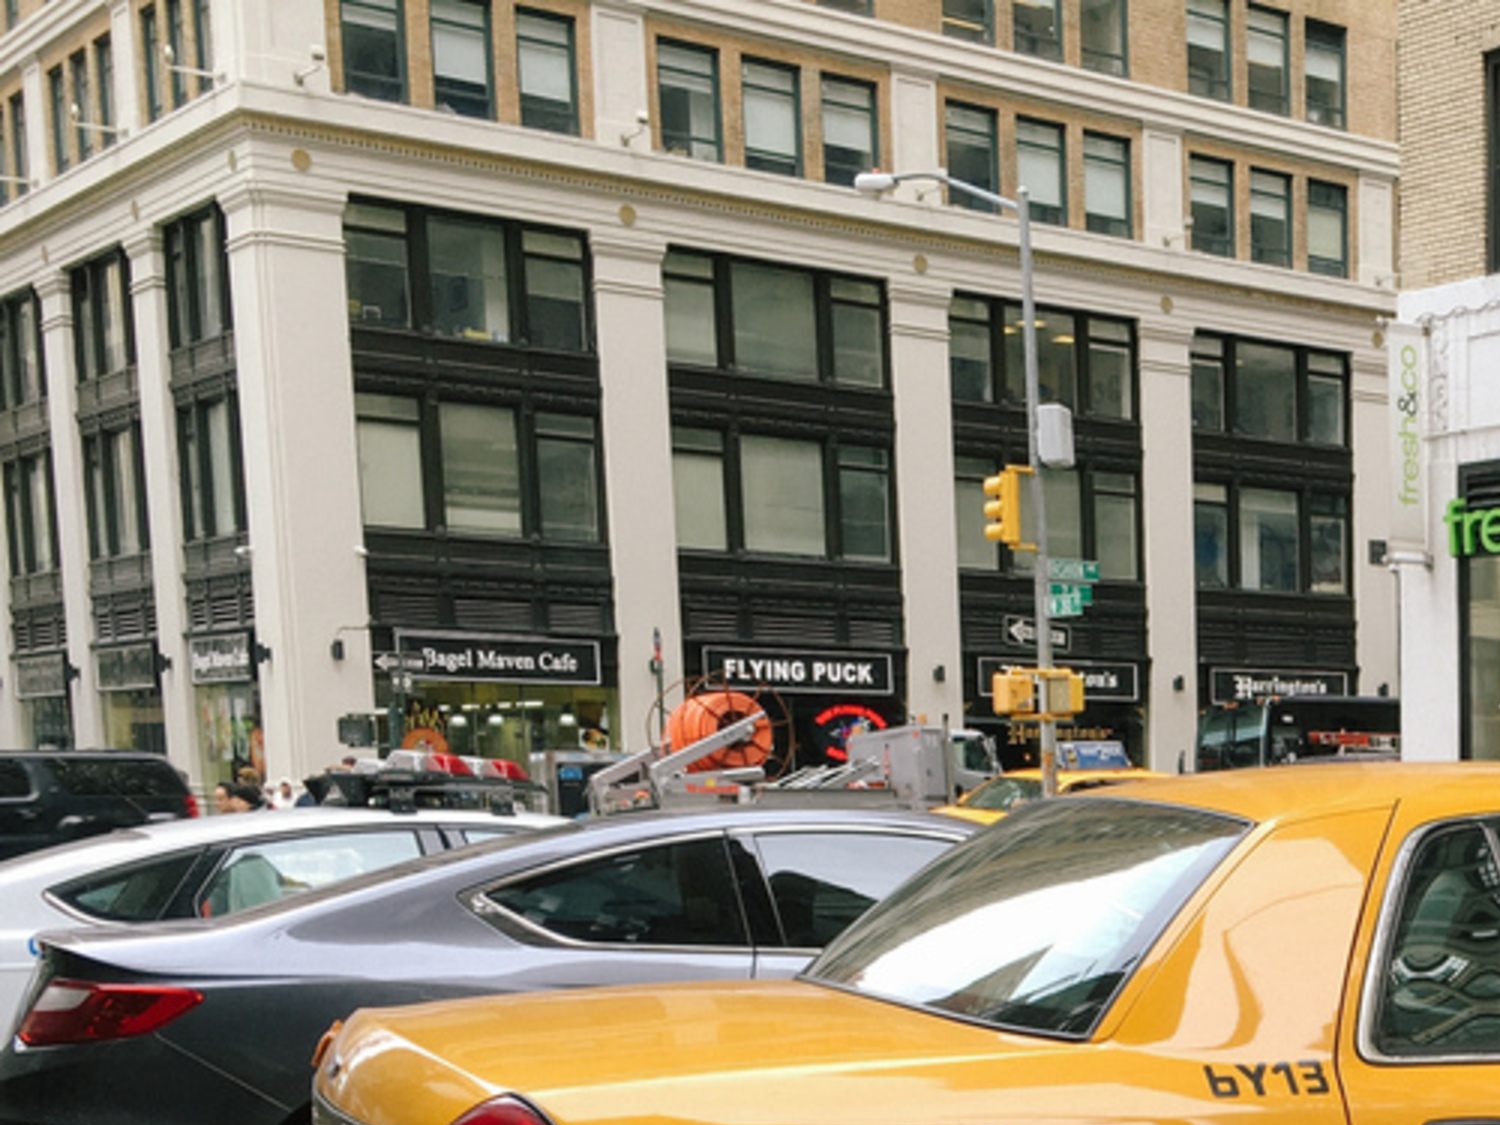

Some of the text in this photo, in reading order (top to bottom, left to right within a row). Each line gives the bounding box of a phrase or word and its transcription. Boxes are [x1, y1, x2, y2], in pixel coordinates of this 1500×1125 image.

[1398, 344, 1419, 506] fresh&co
[422, 647, 473, 672] Bagel
[476, 649, 535, 670] Maven
[538, 652, 579, 672] Cafe
[724, 658, 874, 684] FLYING PUCK
[1233, 674, 1328, 699] Harrington's
[1203, 1060, 1329, 1098] 6Y13
